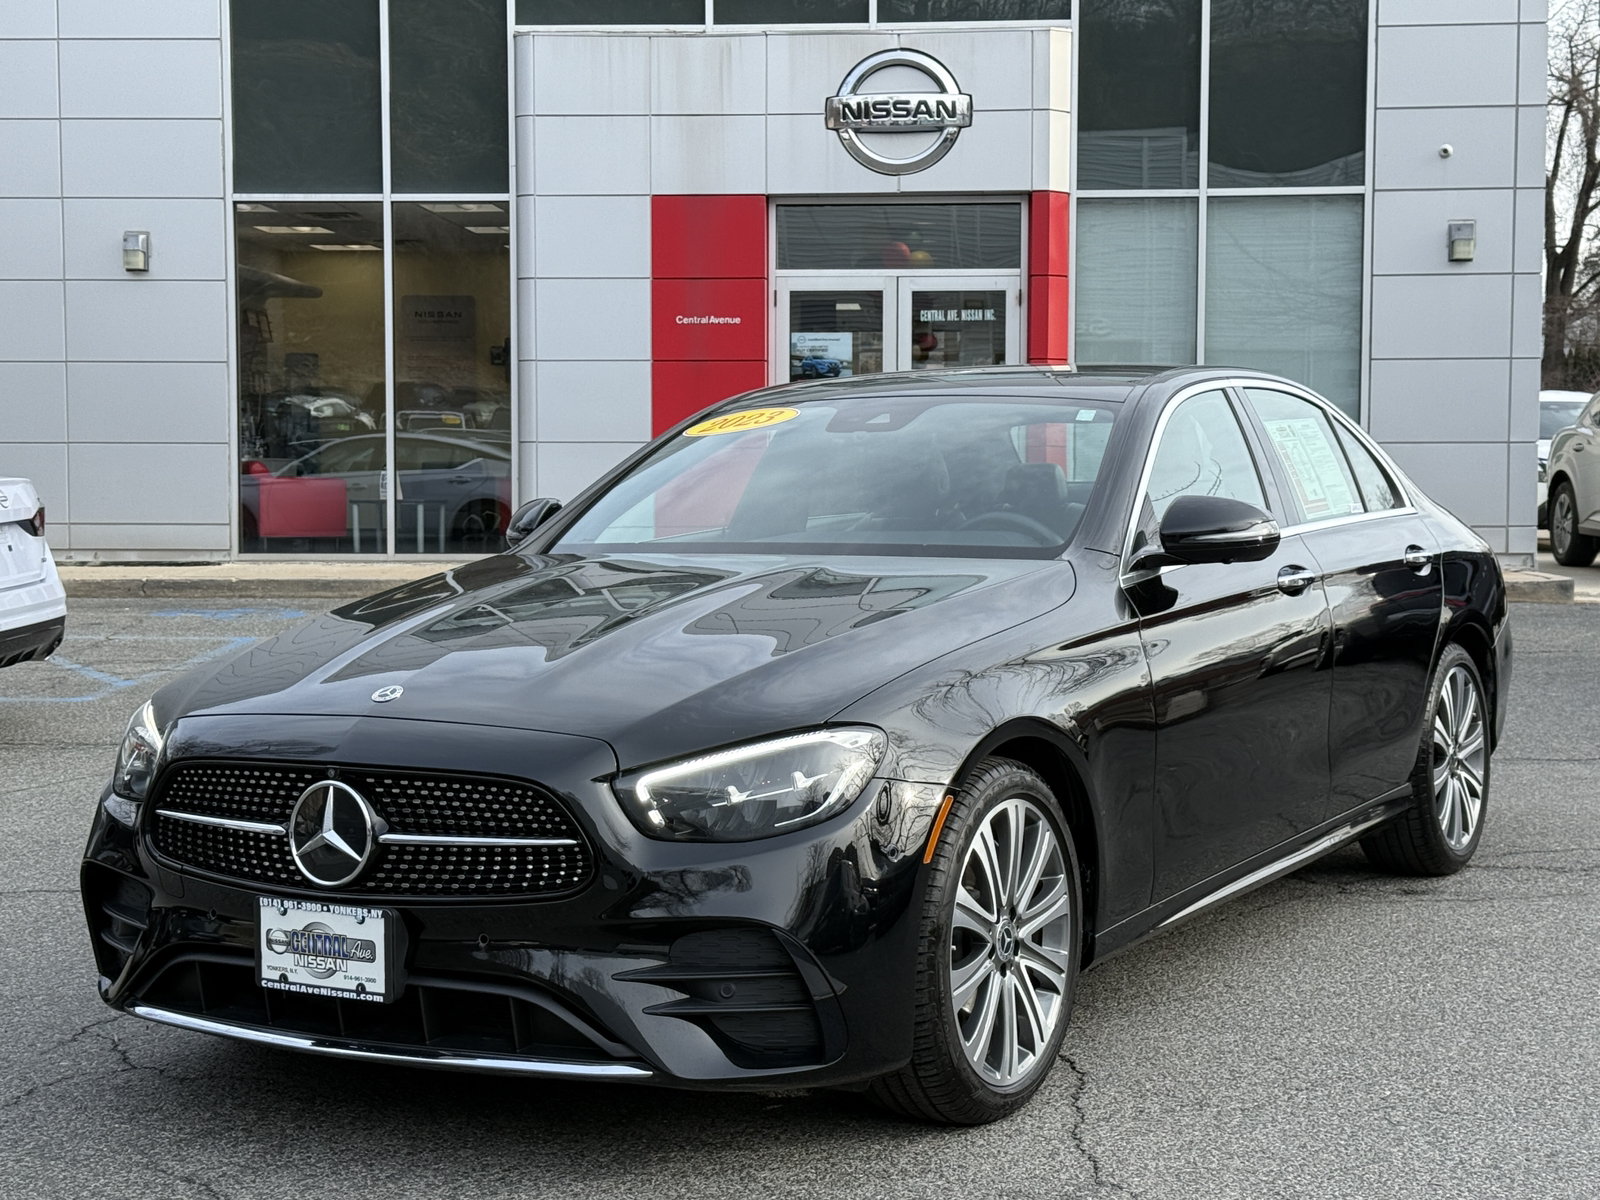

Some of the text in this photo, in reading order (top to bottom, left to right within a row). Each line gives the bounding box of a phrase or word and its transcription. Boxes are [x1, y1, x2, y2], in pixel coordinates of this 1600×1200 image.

[841, 99, 958, 121] NISSAN
[675, 315, 742, 324] Central Avenue
[920, 309, 996, 321] CENTRAL AVE. NISSAN INC.
[697, 410, 786, 433] 2023
[259, 897, 281, 908] (914)
[290, 929, 374, 960] CENTRAL Ave.
[293, 953, 348, 972] NISSAN
[343, 974, 377, 984] 914-961-3900
[261, 980, 384, 1003] CentralAveNissan.com
